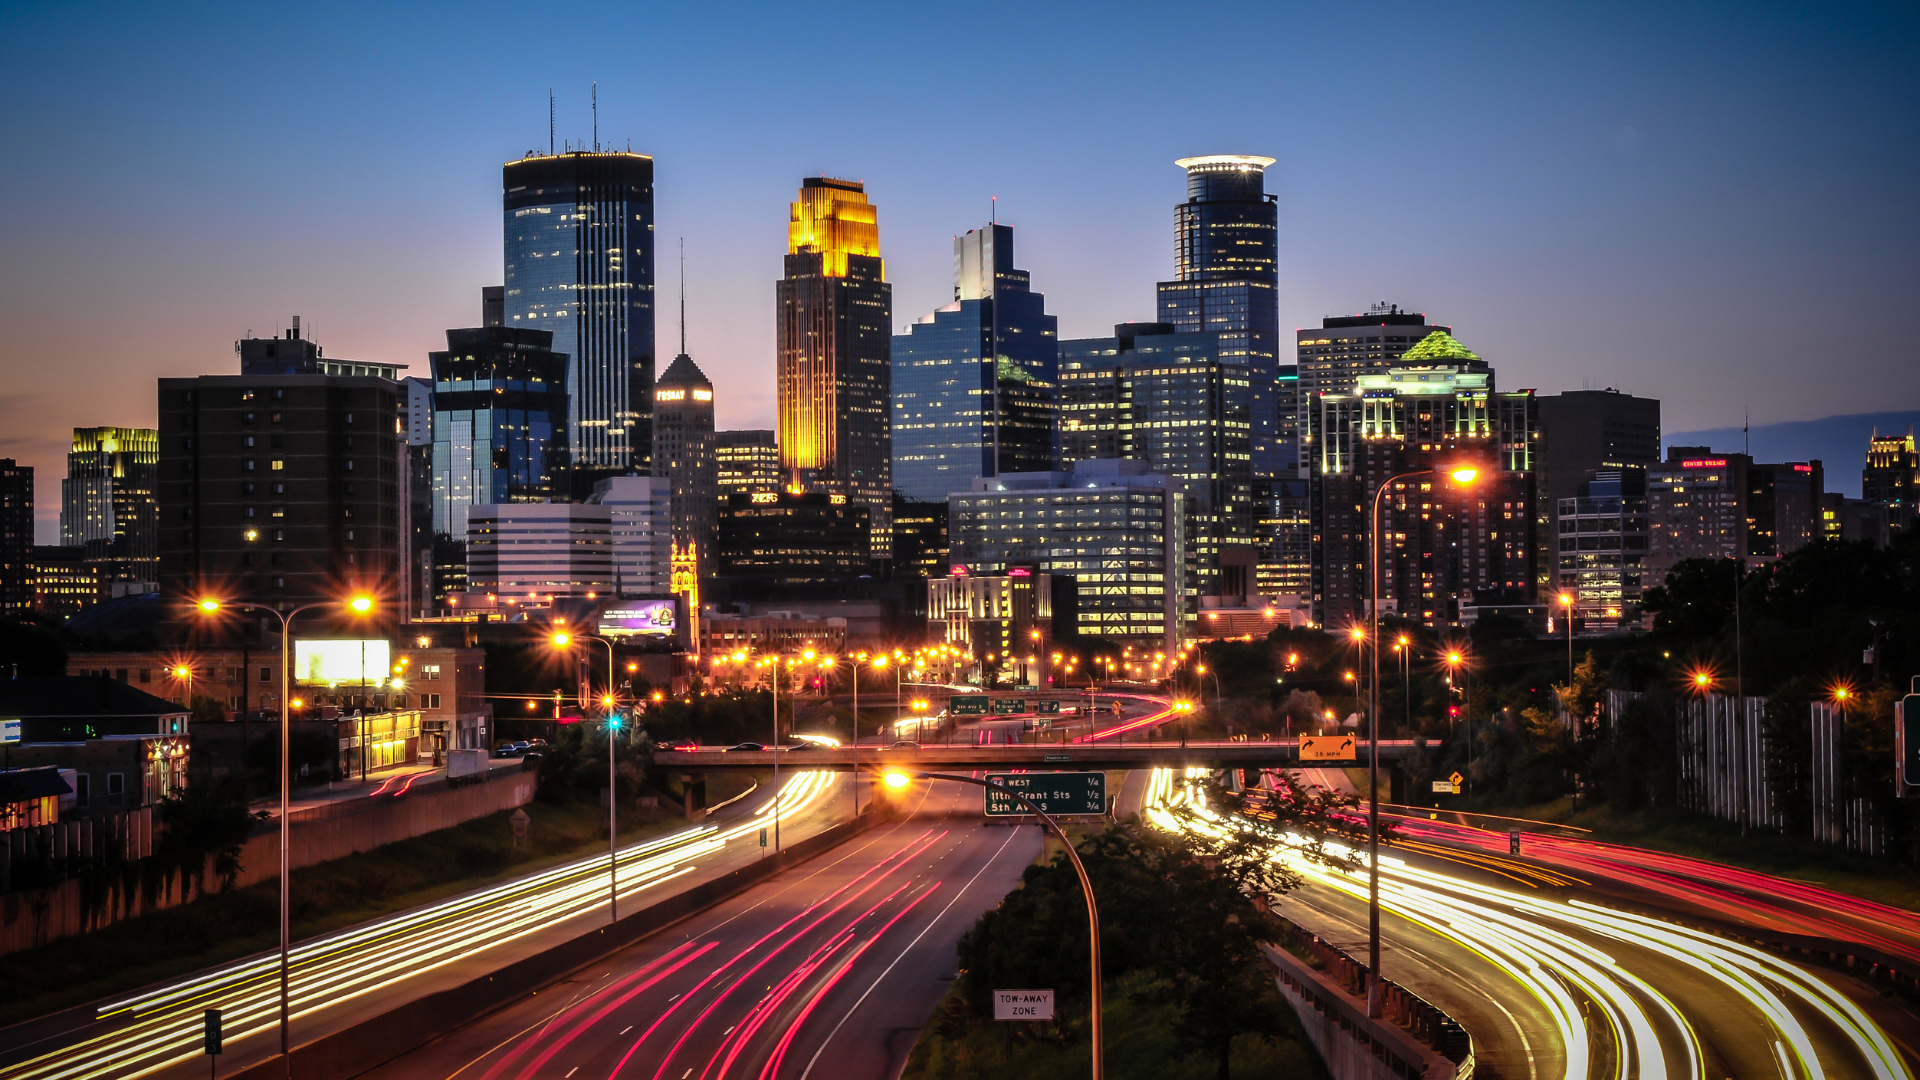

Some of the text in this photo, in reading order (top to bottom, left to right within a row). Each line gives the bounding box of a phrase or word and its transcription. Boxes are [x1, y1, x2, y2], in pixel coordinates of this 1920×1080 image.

[657, 390, 685, 401] FOSHAY
[1008, 779, 1031, 787] WEST
[991, 791, 1011, 800] 11th
[1017, 791, 1048, 800] Grant
[1053, 791, 1070, 799] Sts
[991, 803, 1010, 812] 5th
[1015, 803, 1029, 811] Av
[1041, 802, 1048, 811] S
[1000, 995, 1049, 1003] TOW-AWAY
[1012, 1007, 1036, 1015] ZONE
[210, 1031, 217, 1040] 0
[210, 1043, 216, 1053] 3
